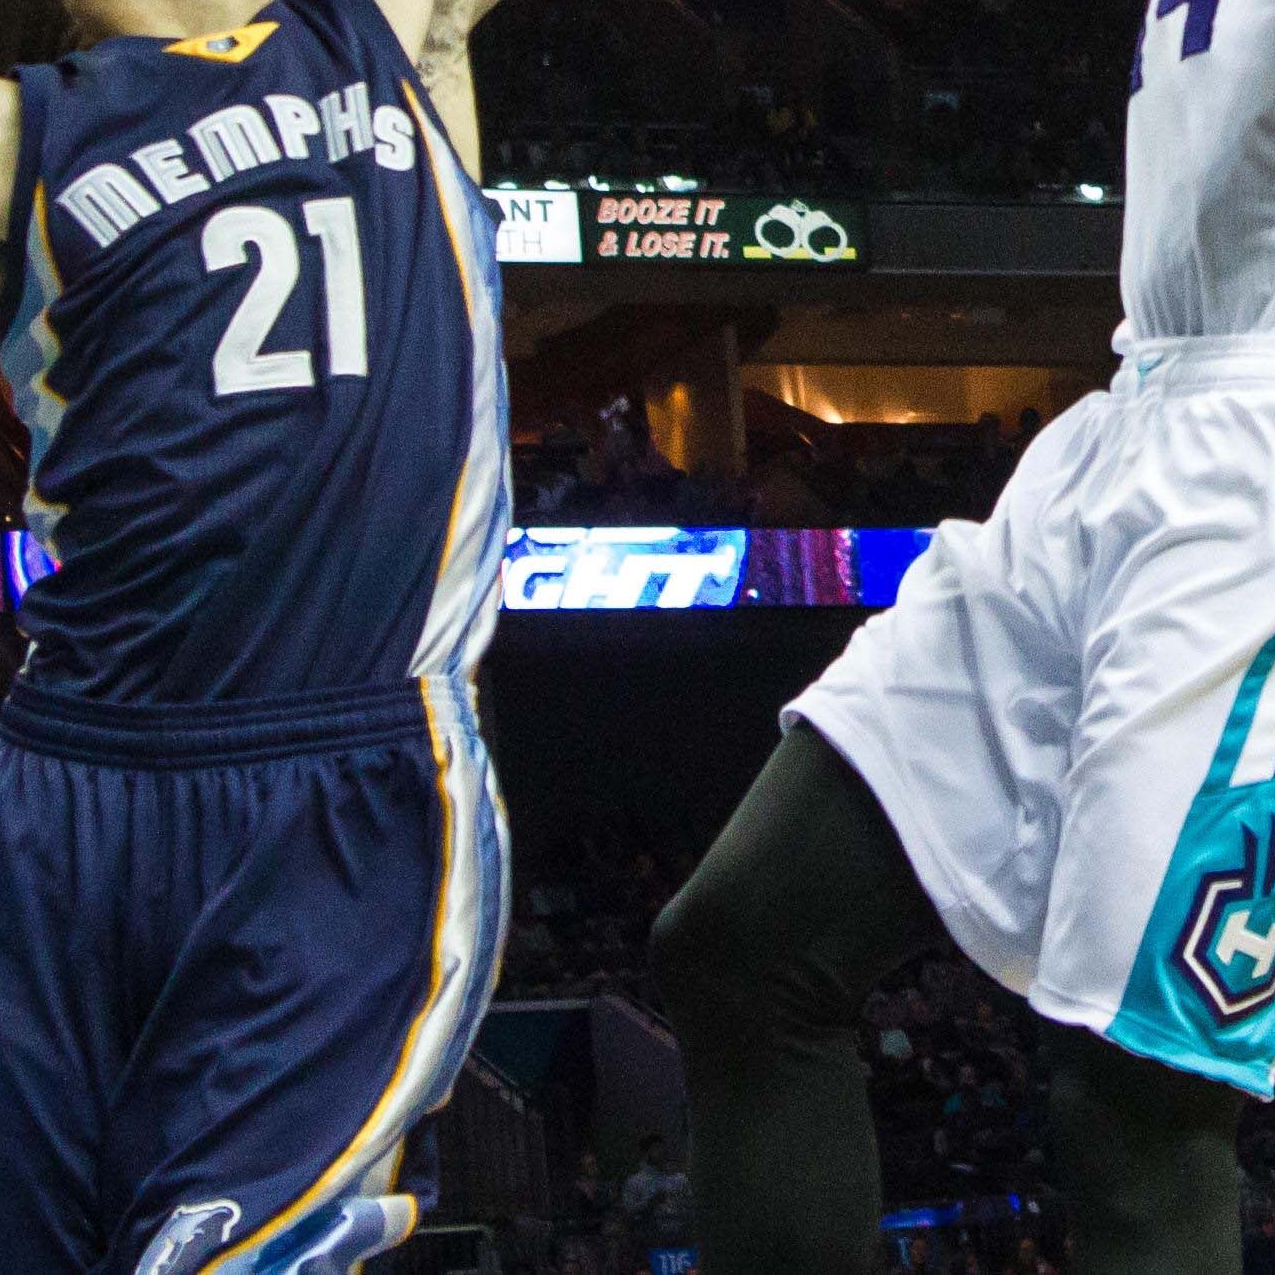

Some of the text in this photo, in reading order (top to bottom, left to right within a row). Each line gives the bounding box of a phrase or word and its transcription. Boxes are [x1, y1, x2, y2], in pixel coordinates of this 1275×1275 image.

[55, 82, 415, 249] MEMPHS
[597, 198, 725, 225] BOOZE IT
[598, 232, 619, 257] &
[626, 232, 694, 258] LOSE
[201, 196, 368, 396] 21
